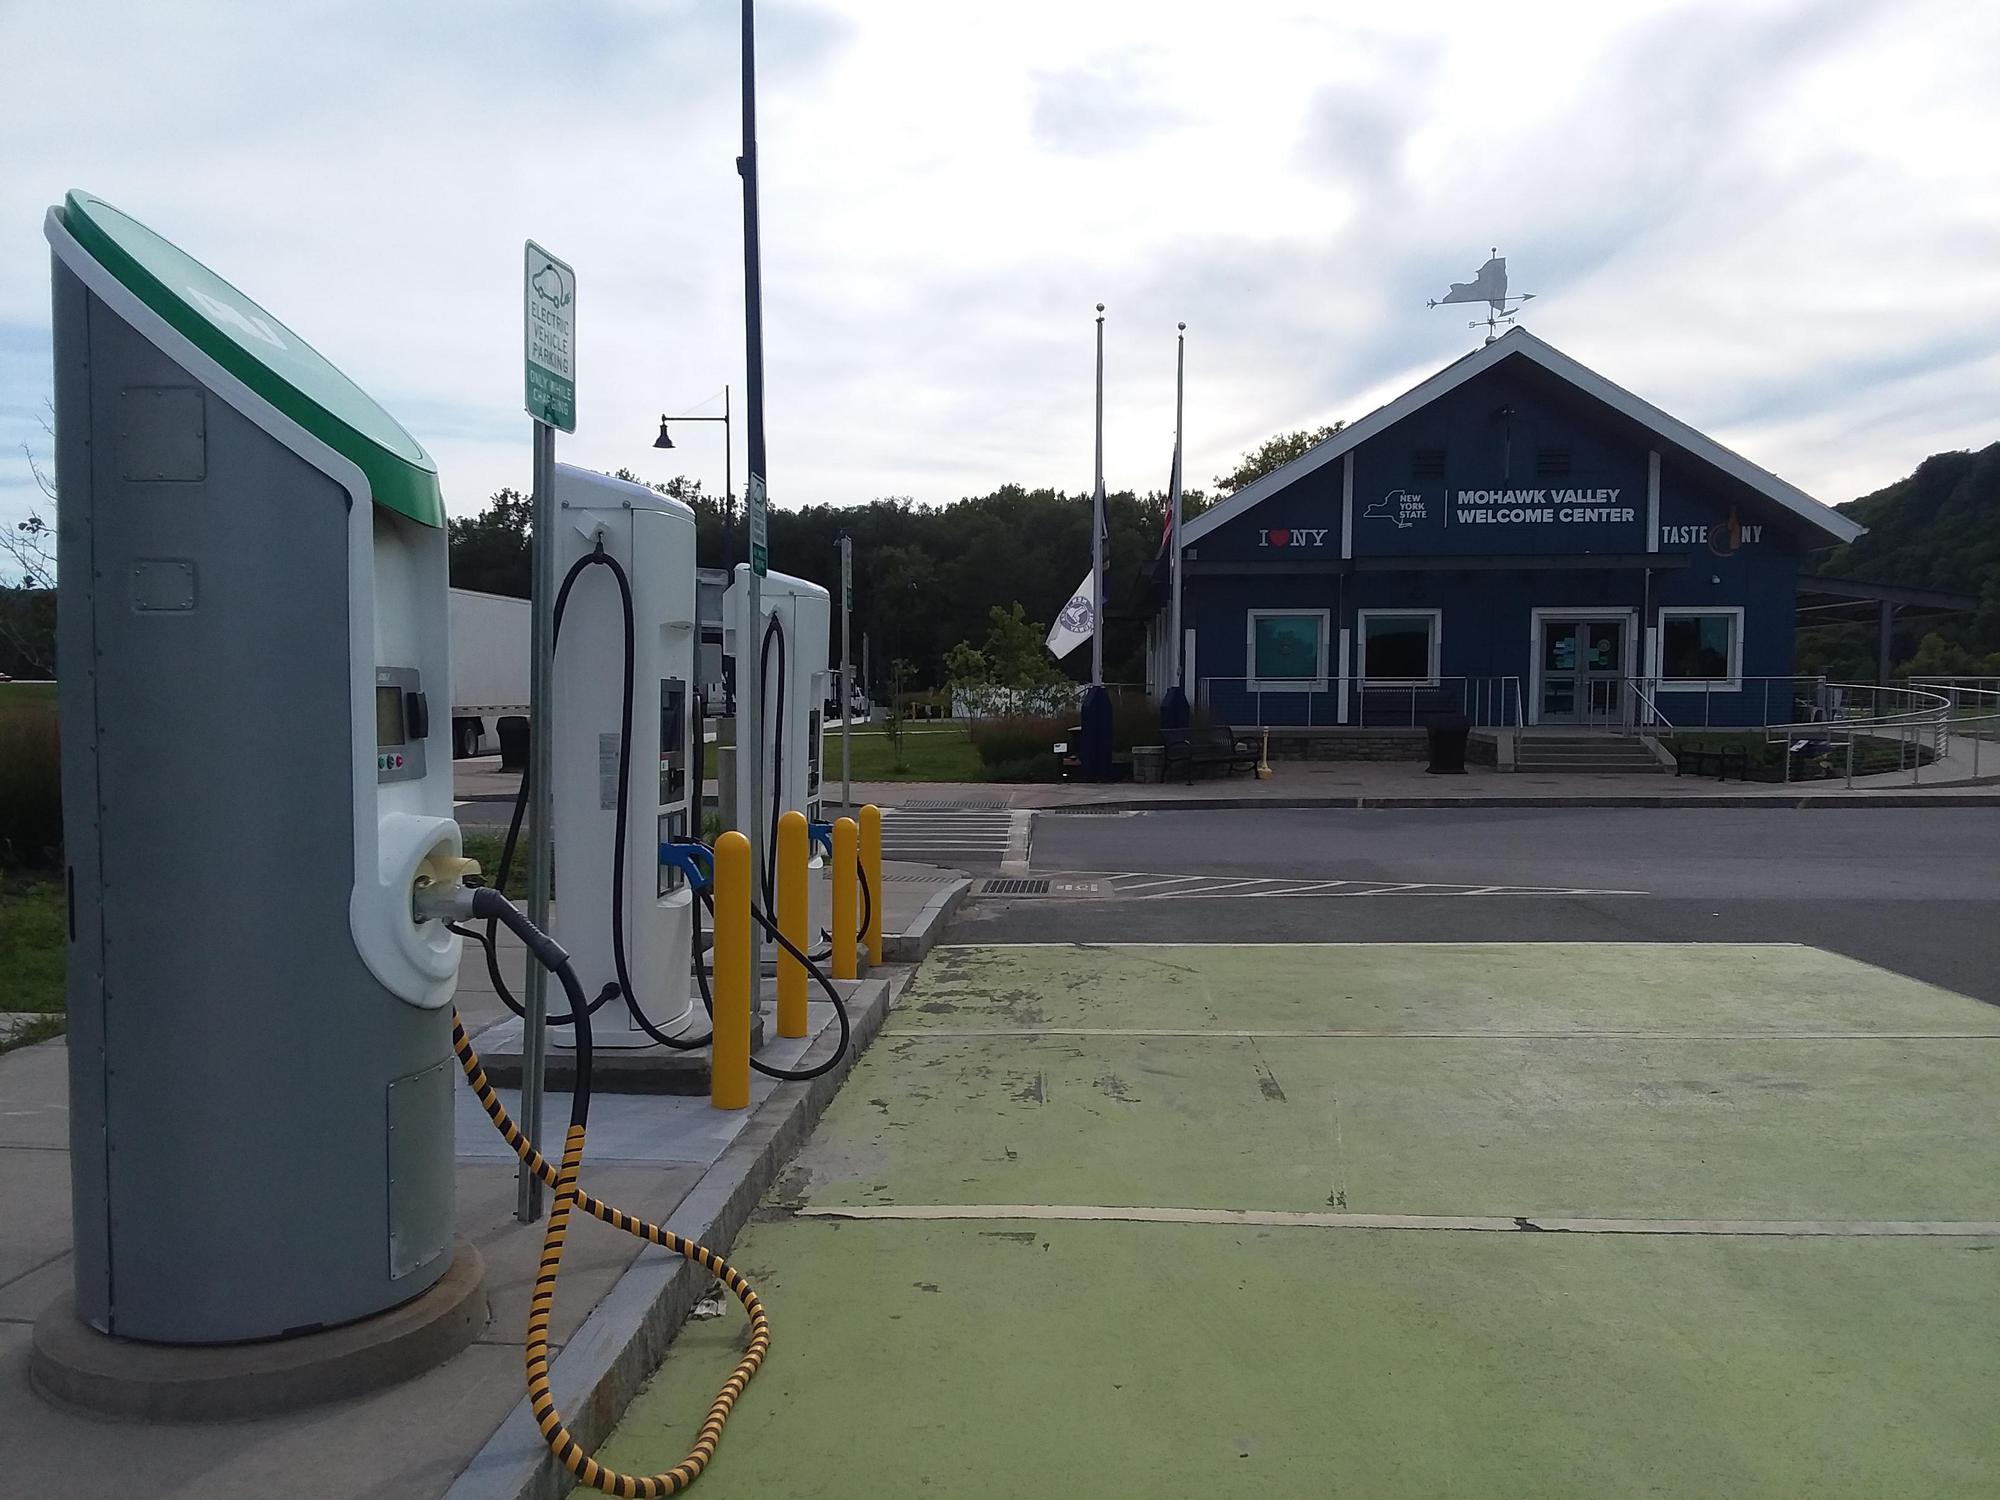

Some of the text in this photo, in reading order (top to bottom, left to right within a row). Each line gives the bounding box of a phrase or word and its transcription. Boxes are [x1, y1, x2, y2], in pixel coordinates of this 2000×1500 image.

[531, 301, 569, 336] ELECTRIC
[533, 323, 568, 355] VEHICLE
[533, 343, 569, 374] PARKING
[530, 369, 548, 390] ONLY
[1400, 494, 1421, 502] NEW
[1457, 489, 1621, 504] MOHAWK VALLEY
[1400, 502, 1425, 510] YORK
[1400, 510, 1428, 518] STATE
[1457, 508, 1635, 523] WELCOME CENTER
[1290, 529, 1328, 546] NY
[1662, 525, 1762, 543] TASTE NY
